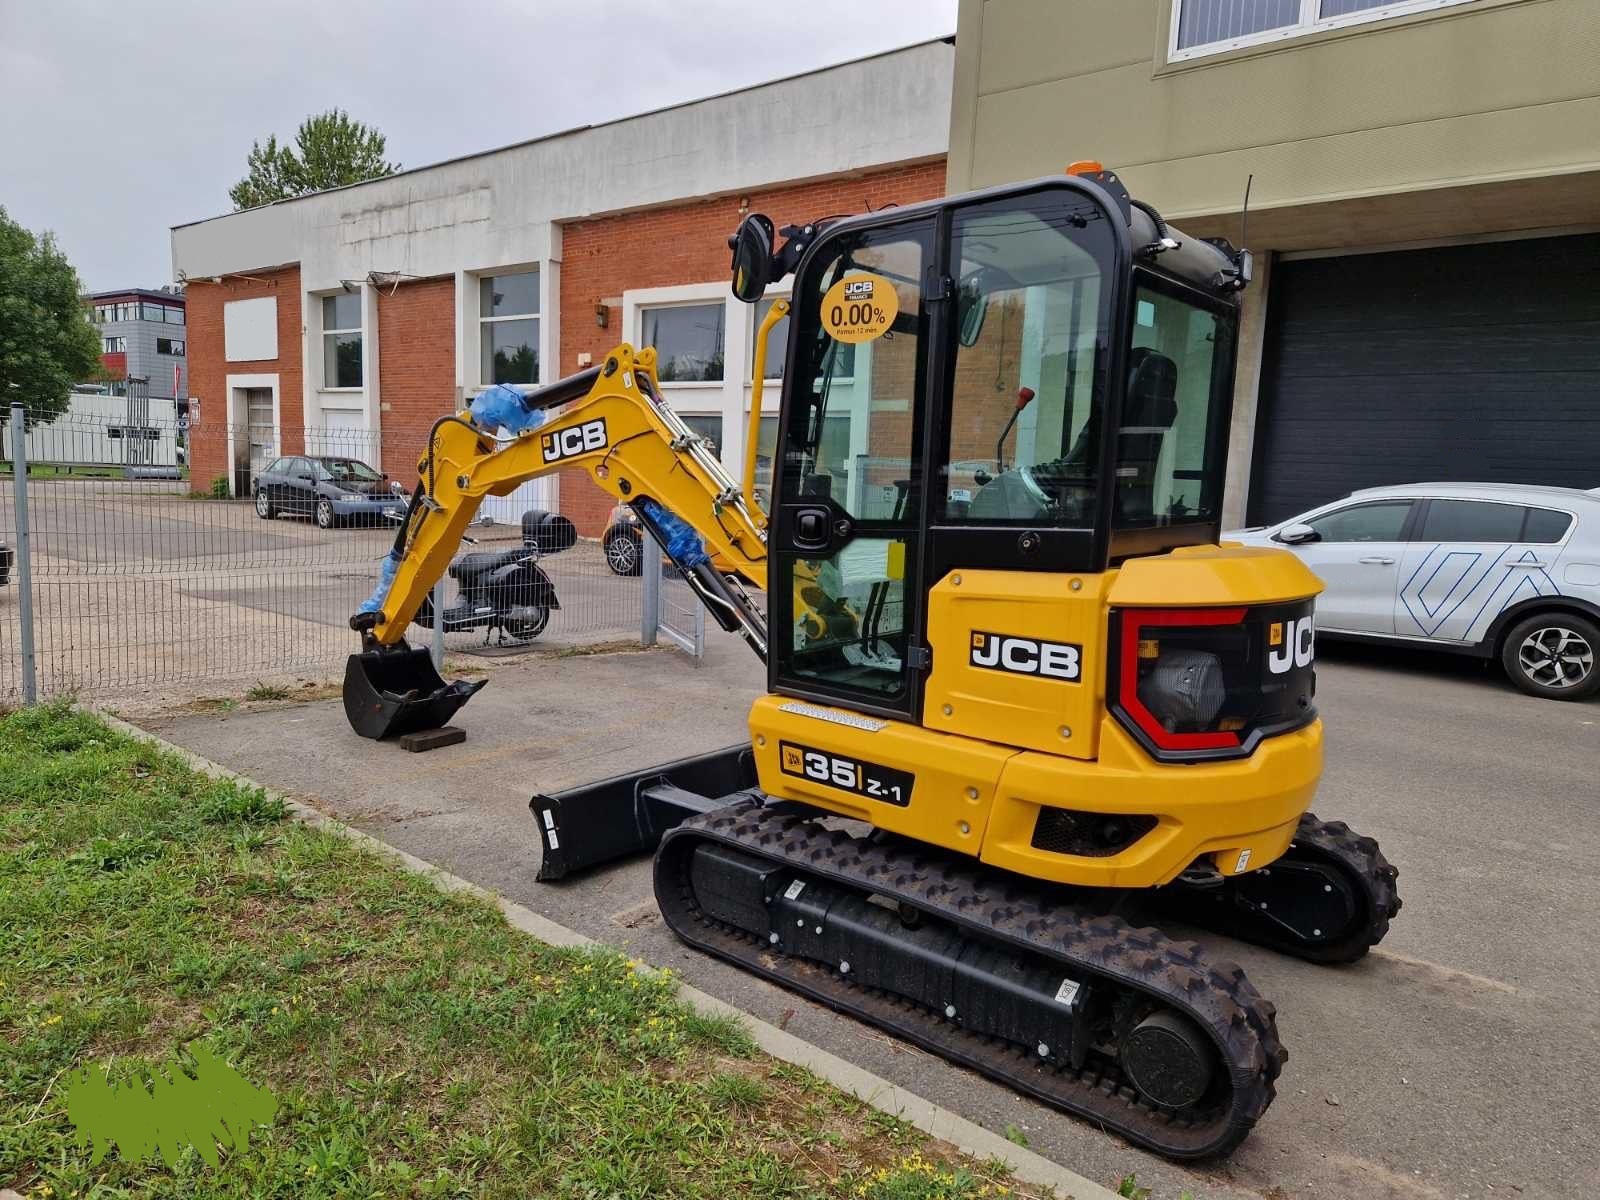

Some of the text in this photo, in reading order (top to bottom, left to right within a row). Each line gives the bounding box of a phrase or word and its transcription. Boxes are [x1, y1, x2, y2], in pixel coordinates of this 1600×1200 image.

[845, 281, 873, 294] JCB
[831, 303, 886, 327] 0.00%
[544, 421, 606, 461] JCB
[973, 636, 1079, 678] JCB
[1269, 615, 1314, 674] JC
[805, 752, 856, 788] 35
[867, 778, 901, 801] Z-1
